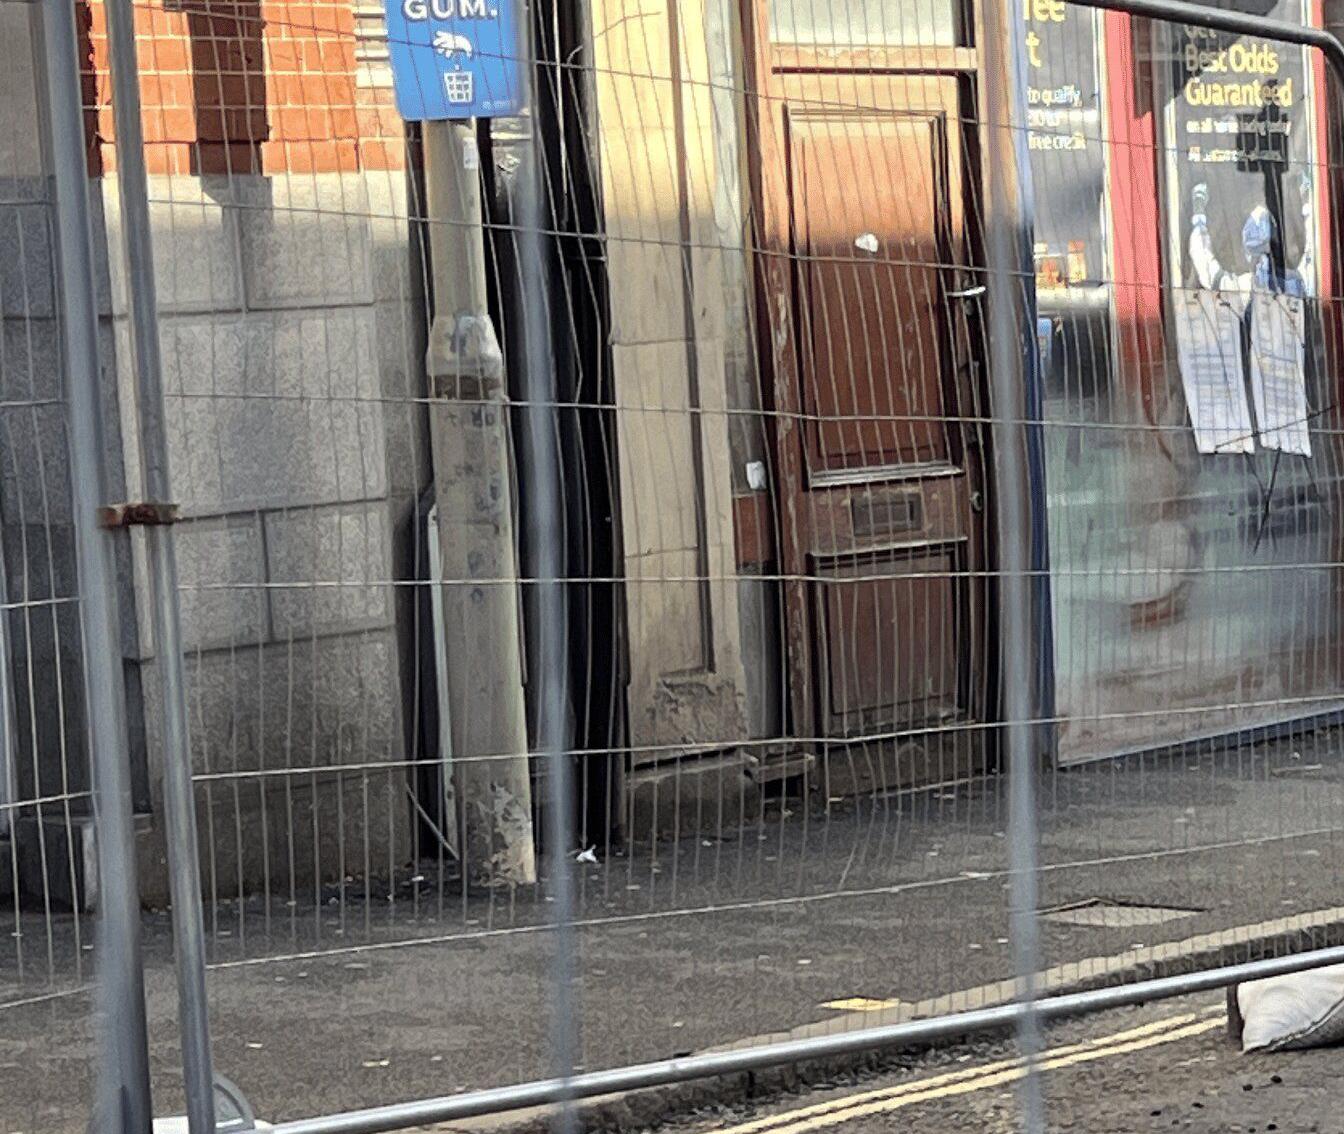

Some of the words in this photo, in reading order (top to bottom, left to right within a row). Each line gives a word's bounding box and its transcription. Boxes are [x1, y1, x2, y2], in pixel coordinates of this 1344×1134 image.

[403, 0, 498, 20] GUM.
[1185, 43, 1228, 72] Best
[1229, 43, 1279, 74] Odds
[1185, 76, 1293, 107] Guaranteed
